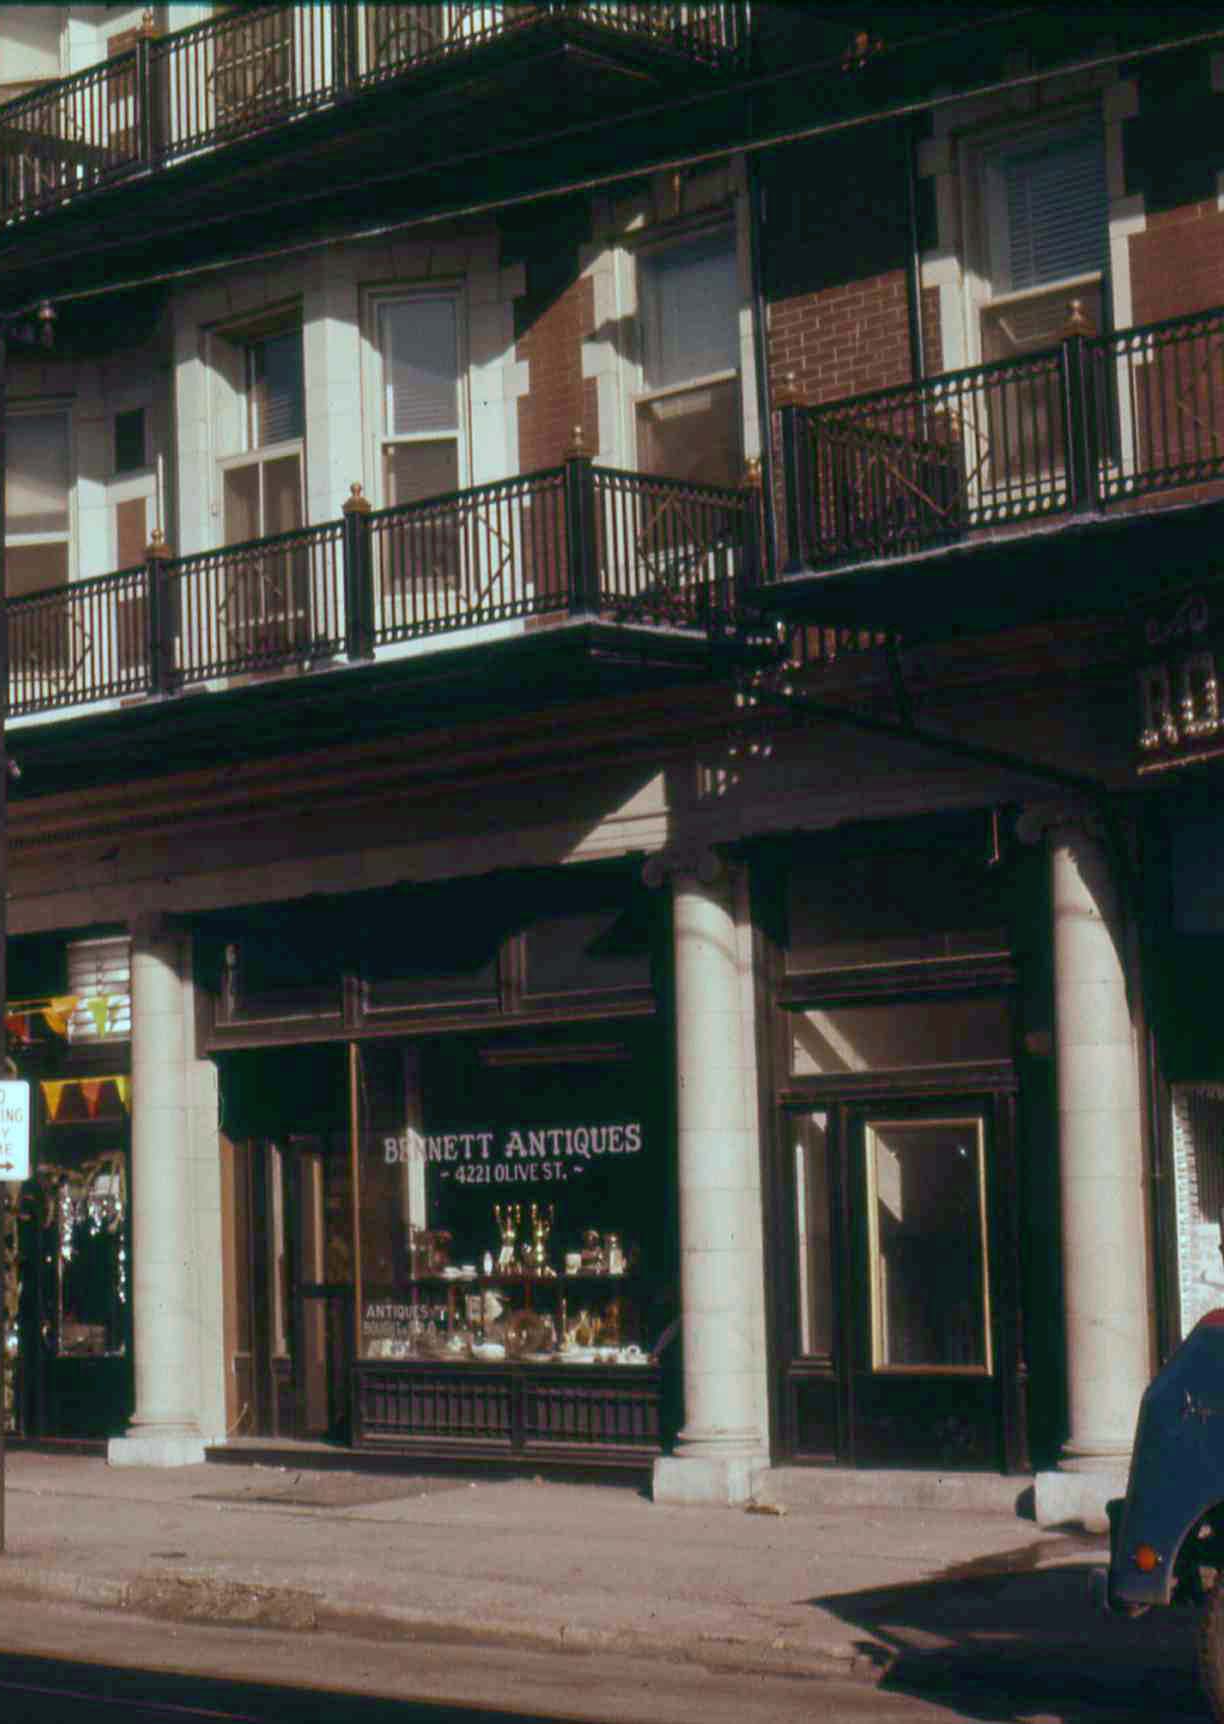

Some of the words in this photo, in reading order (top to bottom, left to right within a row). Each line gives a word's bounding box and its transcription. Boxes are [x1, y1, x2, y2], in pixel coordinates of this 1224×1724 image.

[505, 1123, 642, 1159] ANTIQUES
[455, 1164, 491, 1183] 4221
[495, 1162, 537, 1182] OLIVE
[543, 1161, 568, 1181] ST.
